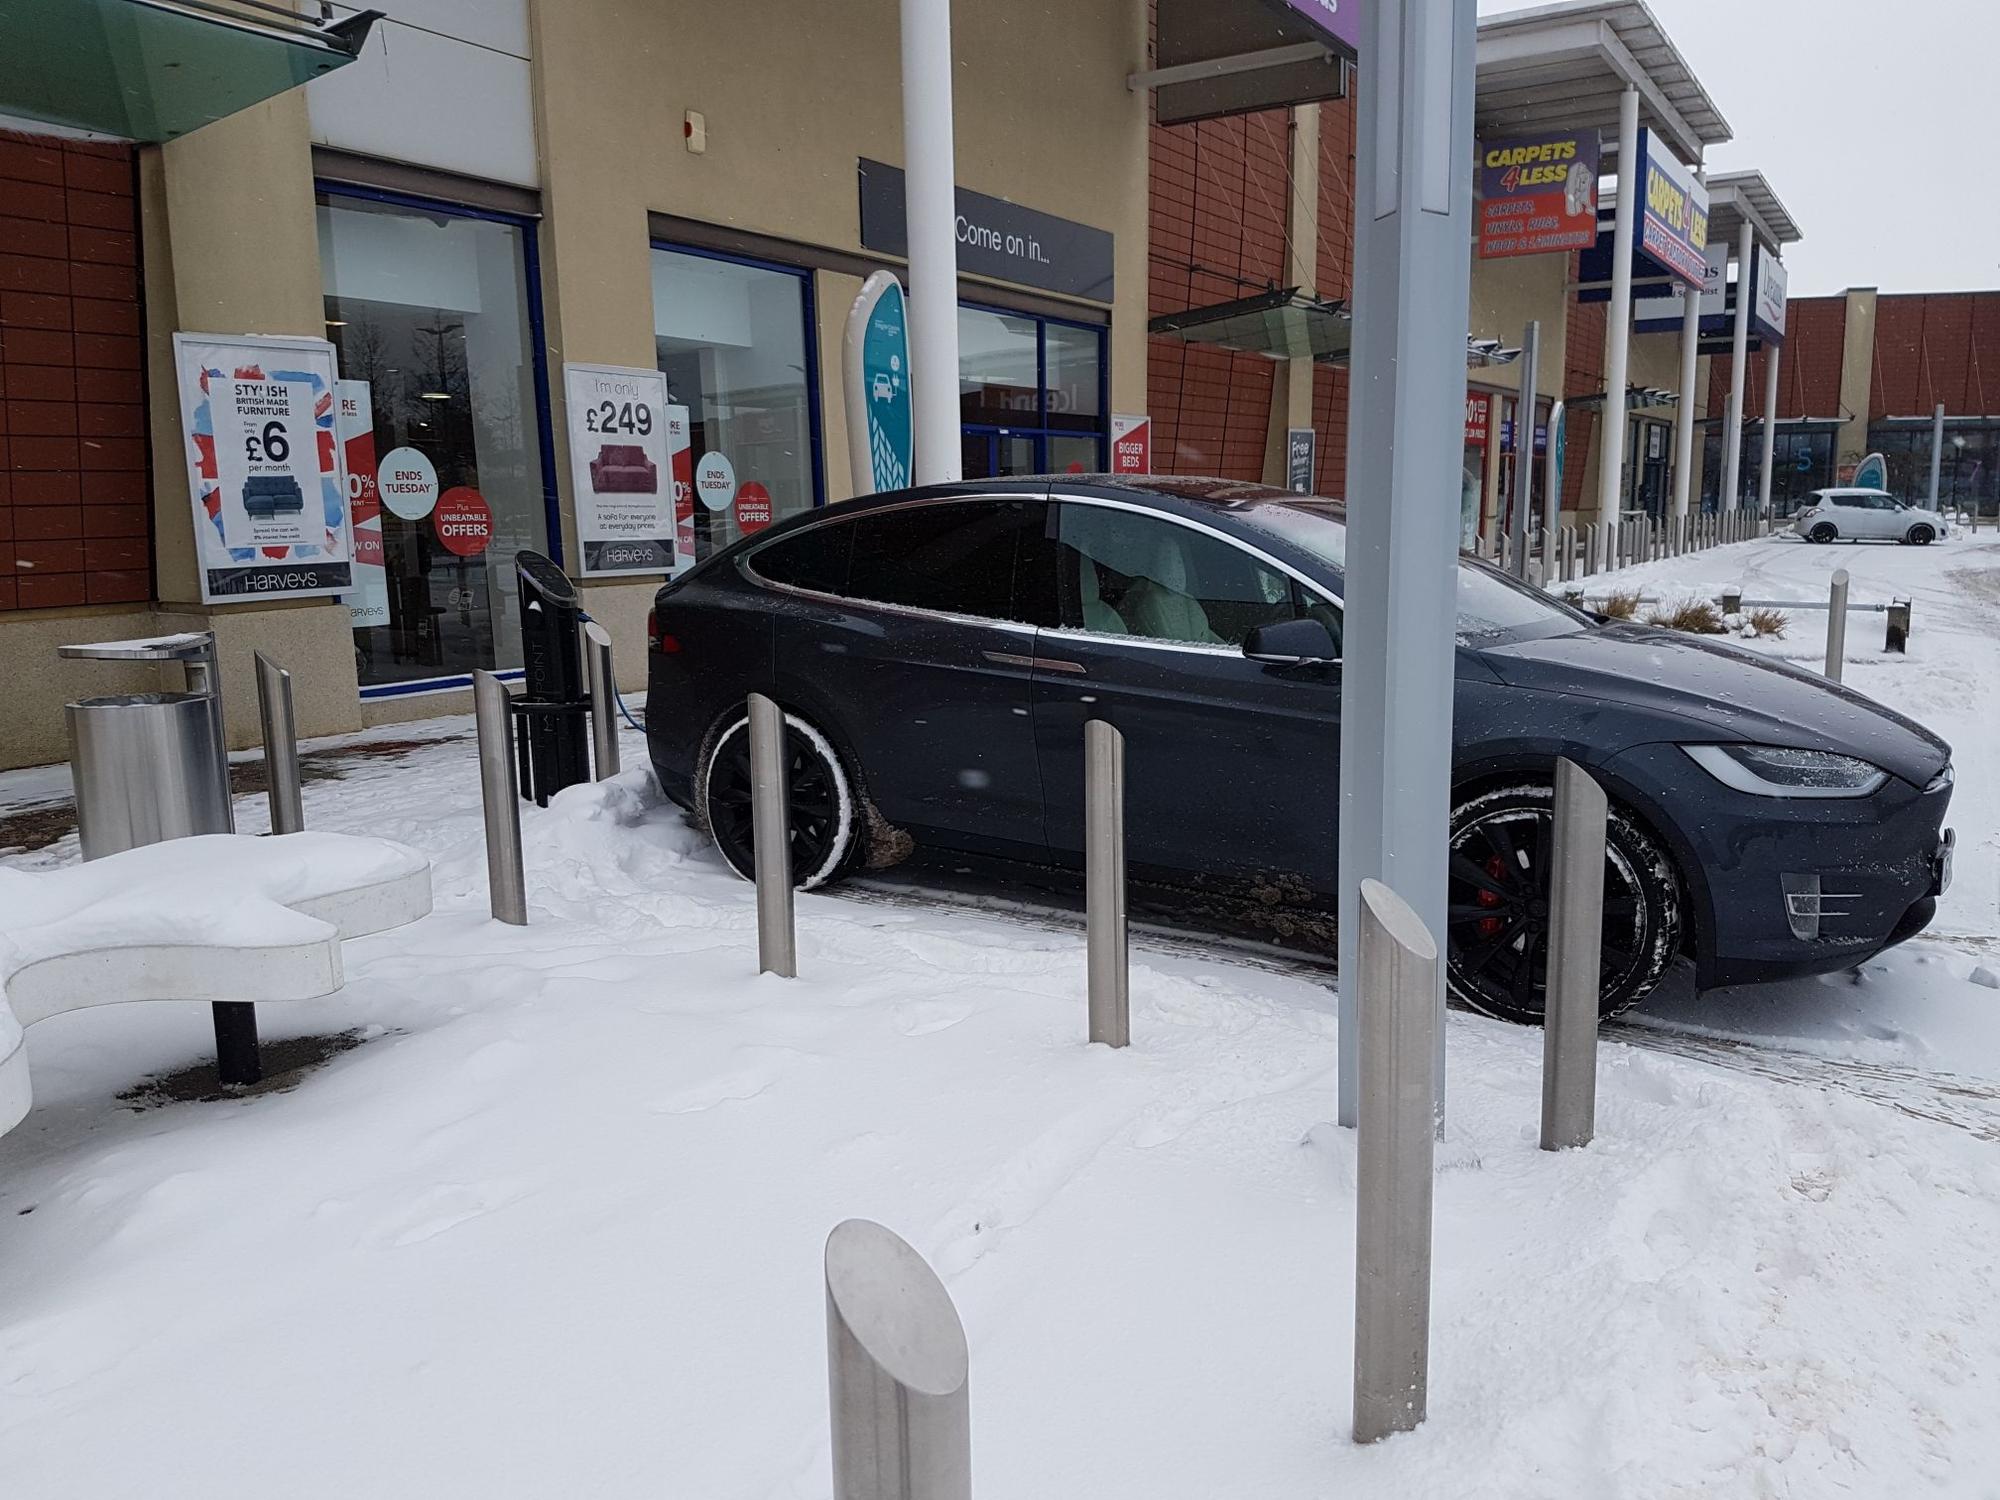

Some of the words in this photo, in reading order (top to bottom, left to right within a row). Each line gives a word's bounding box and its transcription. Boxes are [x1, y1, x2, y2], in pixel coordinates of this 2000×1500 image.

[1486, 141, 1576, 168] CARPETS
[1500, 165, 1520, 193] 4
[1519, 164, 1568, 186] LESS
[1647, 166, 1684, 232] CARPETS
[955, 216, 1002, 251] Come
[1006, 235, 1024, 257] on
[1028, 234, 1050, 264] in...
[615, 382, 639, 400] only
[236, 398, 265, 406] BRITISH
[267, 399, 289, 407] MADE
[237, 407, 291, 417] FURNITURE
[586, 401, 652, 436] £249
[246, 421, 290, 462] £6
[1118, 441, 1144, 455] BIGGER
[1122, 455, 1140, 468] BEDS
[249, 465, 262, 474] per
[265, 463, 291, 472] month
[395, 471, 423, 481] ENDS
[707, 471, 725, 479] ENDS
[441, 514, 487, 522] UNBEATABLE
[740, 512, 770, 522] OFFERS
[442, 525, 488, 537] OFFERS
[364, 541, 381, 551] ON
